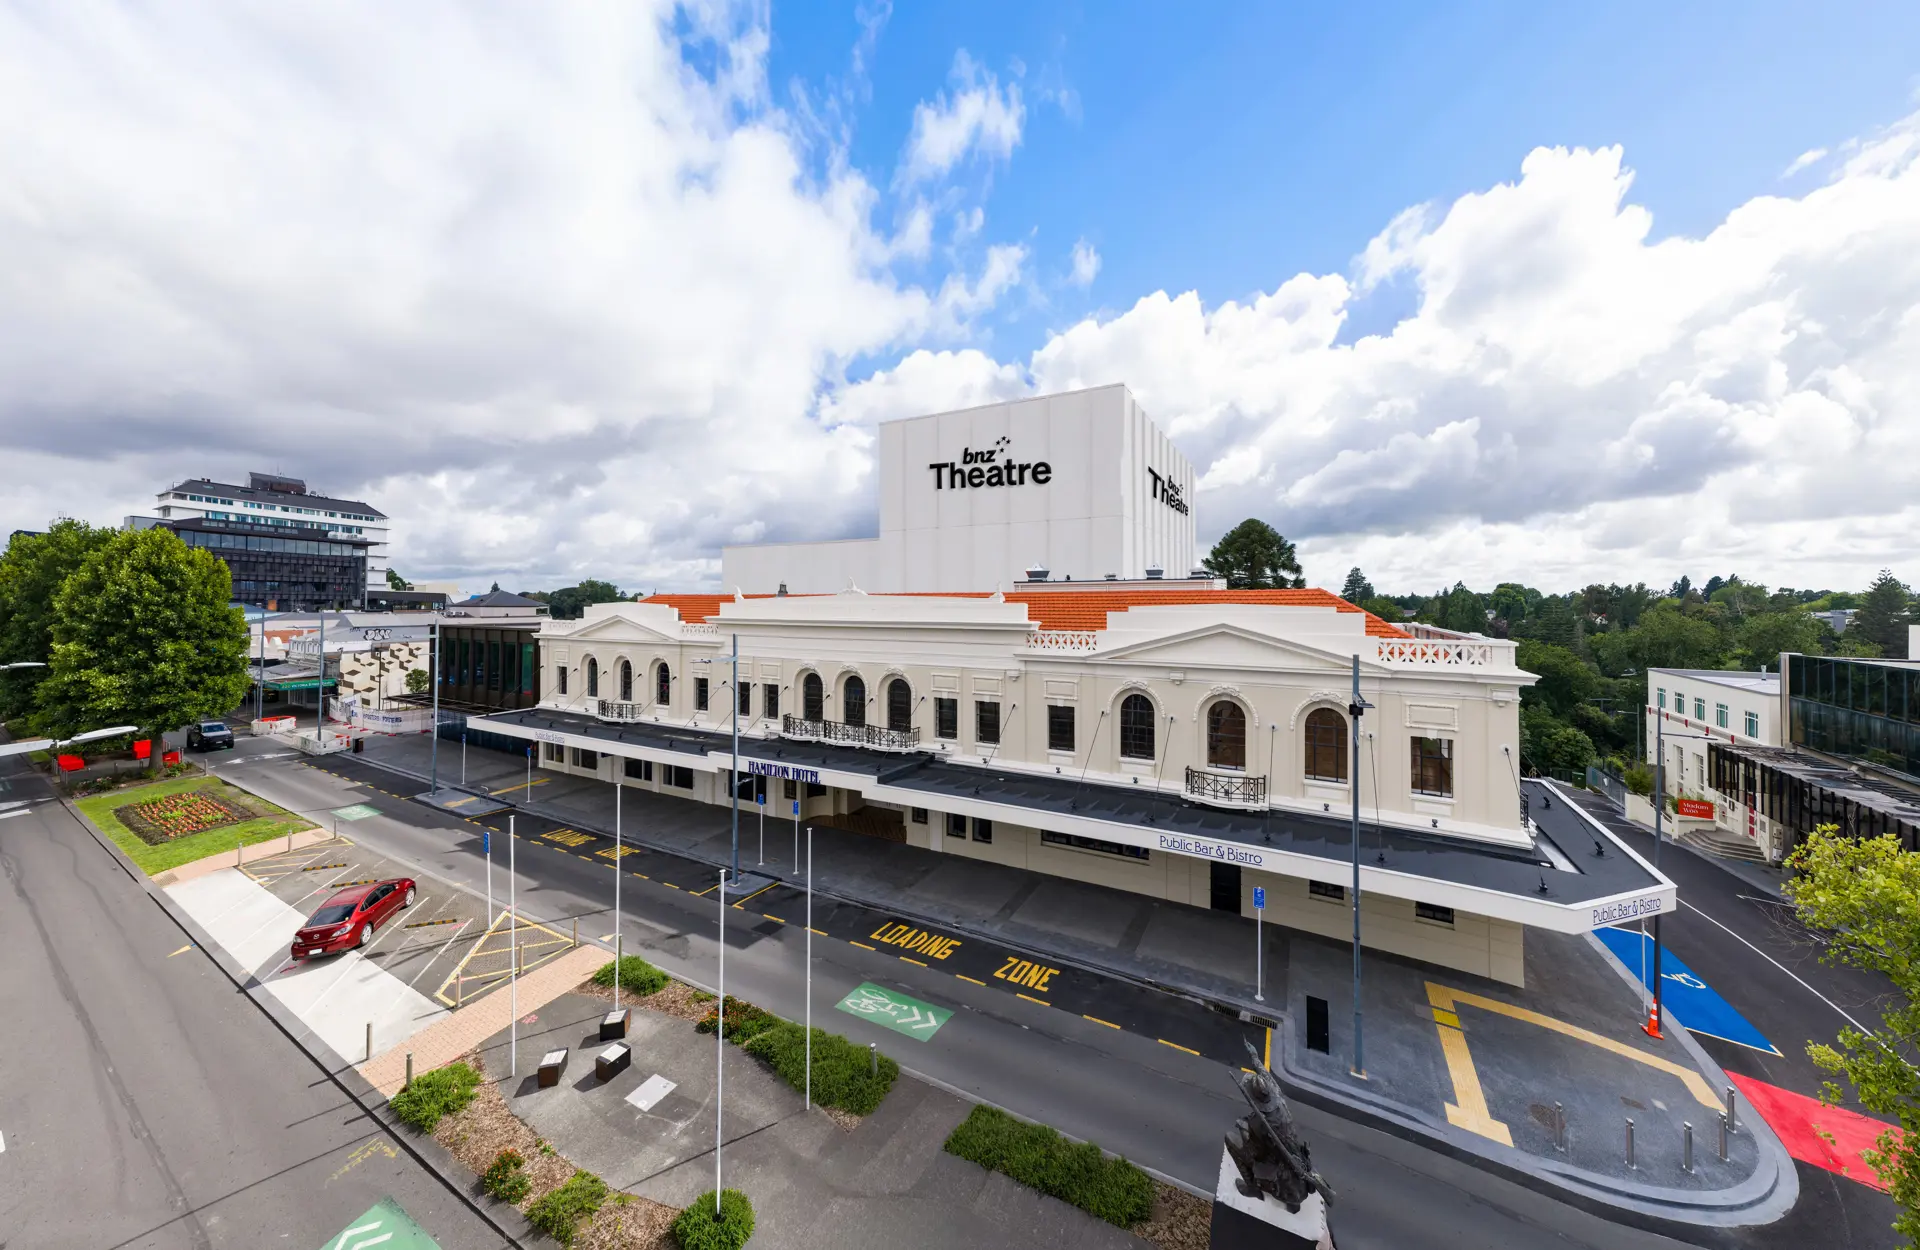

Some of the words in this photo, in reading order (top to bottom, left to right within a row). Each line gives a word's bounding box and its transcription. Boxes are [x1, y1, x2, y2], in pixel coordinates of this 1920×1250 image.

[963, 448, 996, 465] bnz
[929, 459, 1052, 489] Theatre
[1168, 475, 1180, 496] bnz
[1148, 466, 1188, 516] Theatre
[748, 761, 789, 779] HAMILTON
[791, 767, 821, 784] HOTEL
[1160, 835, 1192, 852] Public
[1194, 841, 1214, 855] Bar
[1215, 846, 1225, 859] &
[1227, 847, 1262, 864] Bistro
[1593, 905, 1617, 923] Public
[1618, 903, 1632, 917] Bar
[1632, 900, 1638, 915] &
[1640, 898, 1661, 914] Bistro
[869, 921, 962, 960] LOADING
[993, 956, 1060, 992] ZONE
